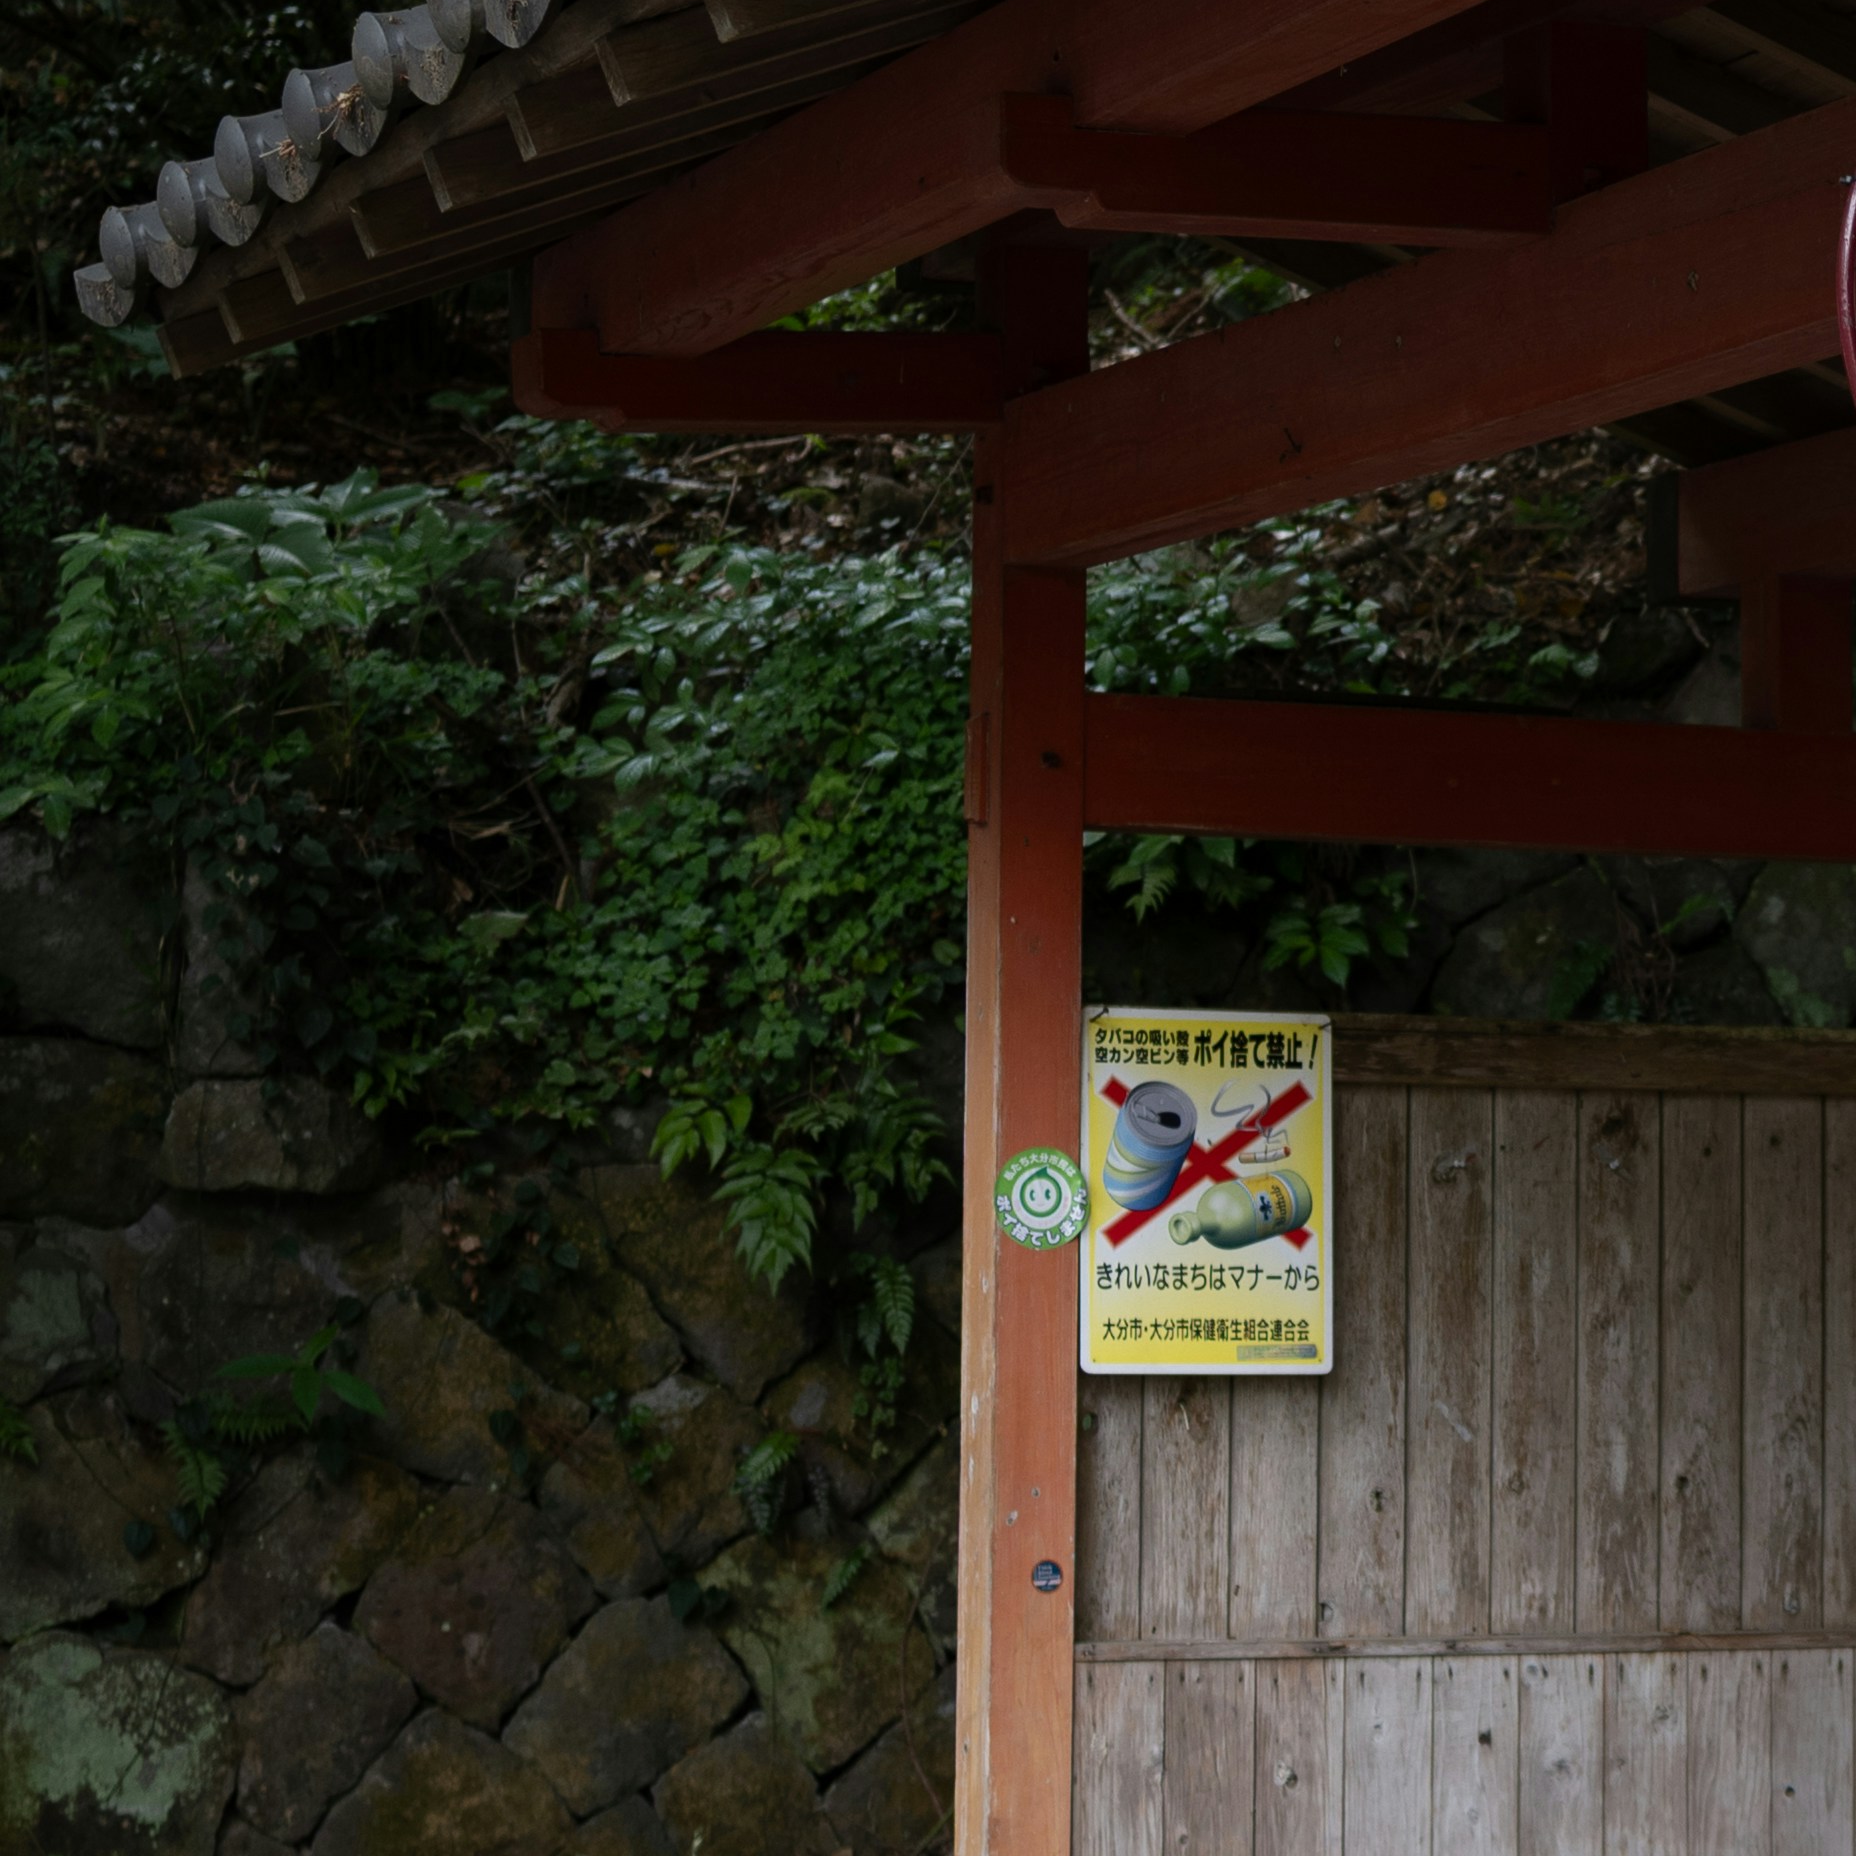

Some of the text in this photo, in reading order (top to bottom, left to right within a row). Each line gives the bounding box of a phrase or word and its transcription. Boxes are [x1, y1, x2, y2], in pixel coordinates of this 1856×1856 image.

[1095, 1028, 1190, 1047] タバコの吸い殻
[1194, 1029, 1319, 1070] ポイ捨て禁止!
[1095, 1047, 1190, 1066] 空カン空ビン等
[996, 1188, 1087, 1246] ポイ捨てしません
[1096, 1262, 1320, 1291] きれいなまちはマナーから
